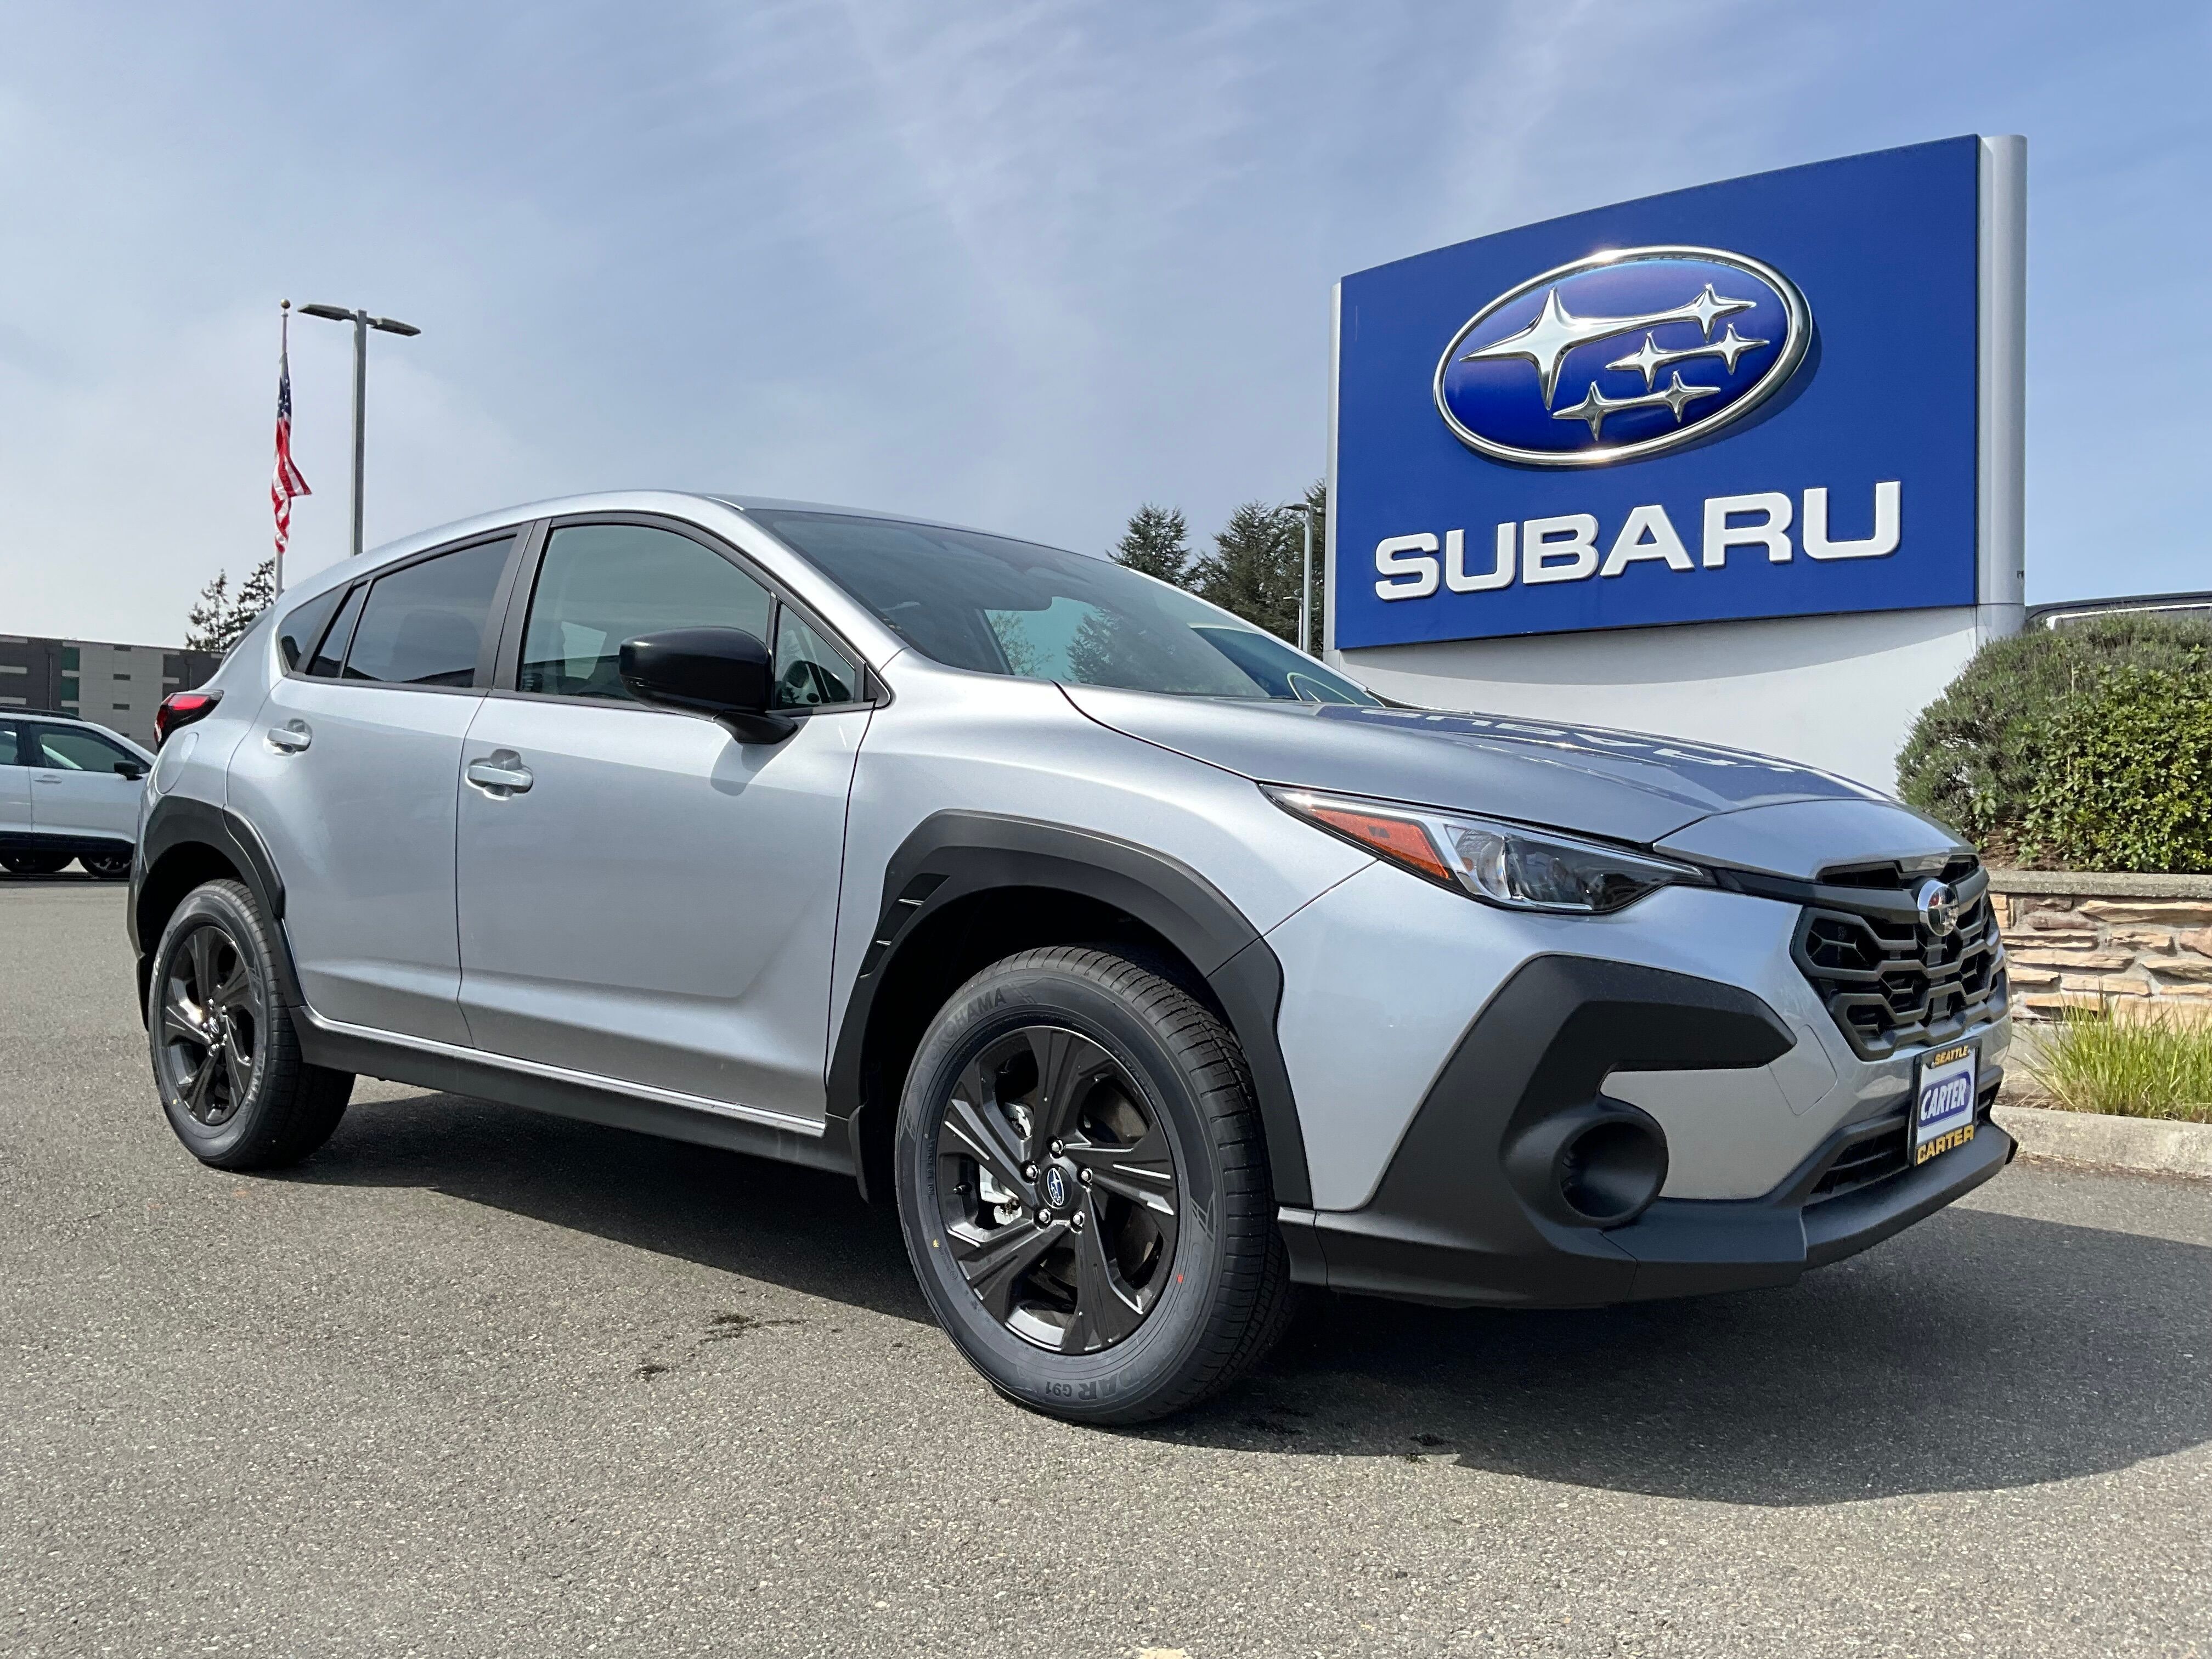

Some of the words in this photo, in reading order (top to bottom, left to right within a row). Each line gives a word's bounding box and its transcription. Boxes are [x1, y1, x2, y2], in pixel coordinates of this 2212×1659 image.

[1375, 481, 1901, 601] SUBARU
[1934, 1045, 1969, 1065] SEATTLE
[1921, 1077, 1967, 1121] CARTER
[1917, 1124, 1974, 1165] CARTER
[1045, 1381, 1073, 1398] G91
